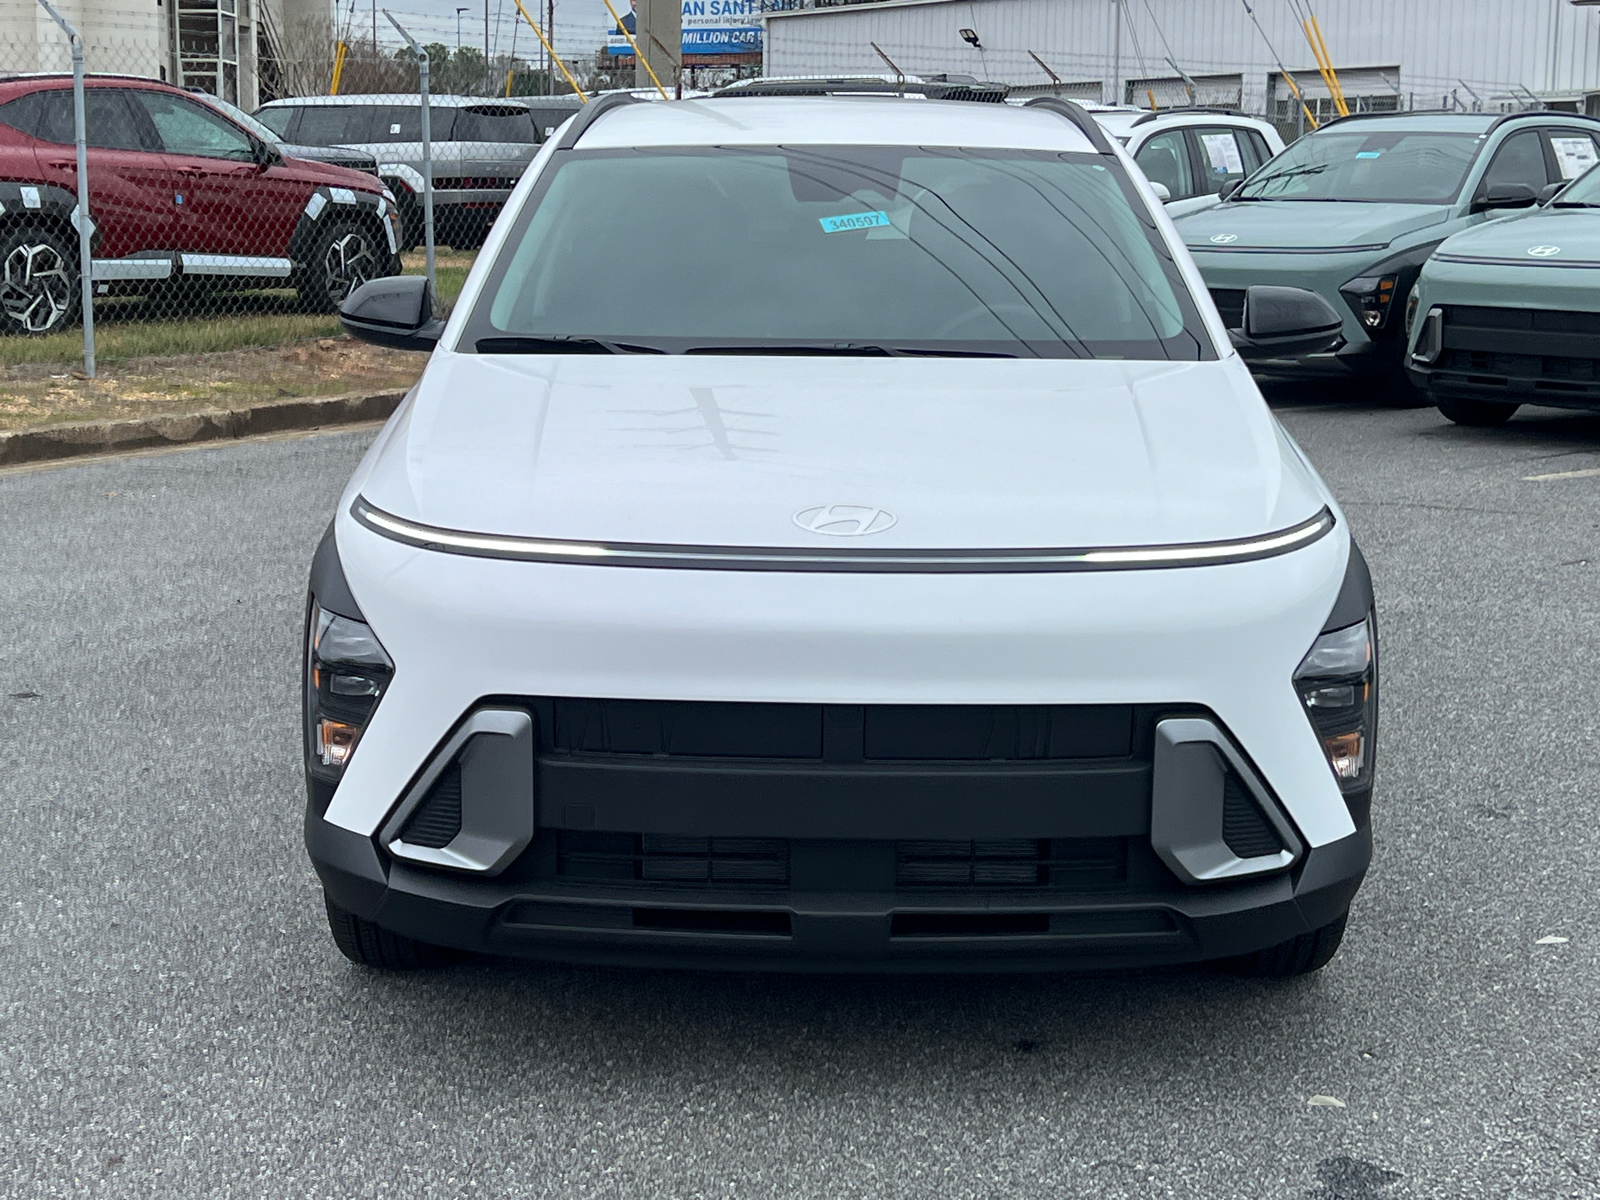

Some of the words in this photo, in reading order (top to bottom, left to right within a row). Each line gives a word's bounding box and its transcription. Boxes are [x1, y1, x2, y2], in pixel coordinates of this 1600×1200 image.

[687, 16, 720, 26] personal
[681, 31, 729, 44] MILLION
[731, 31, 755, 44] CAR
